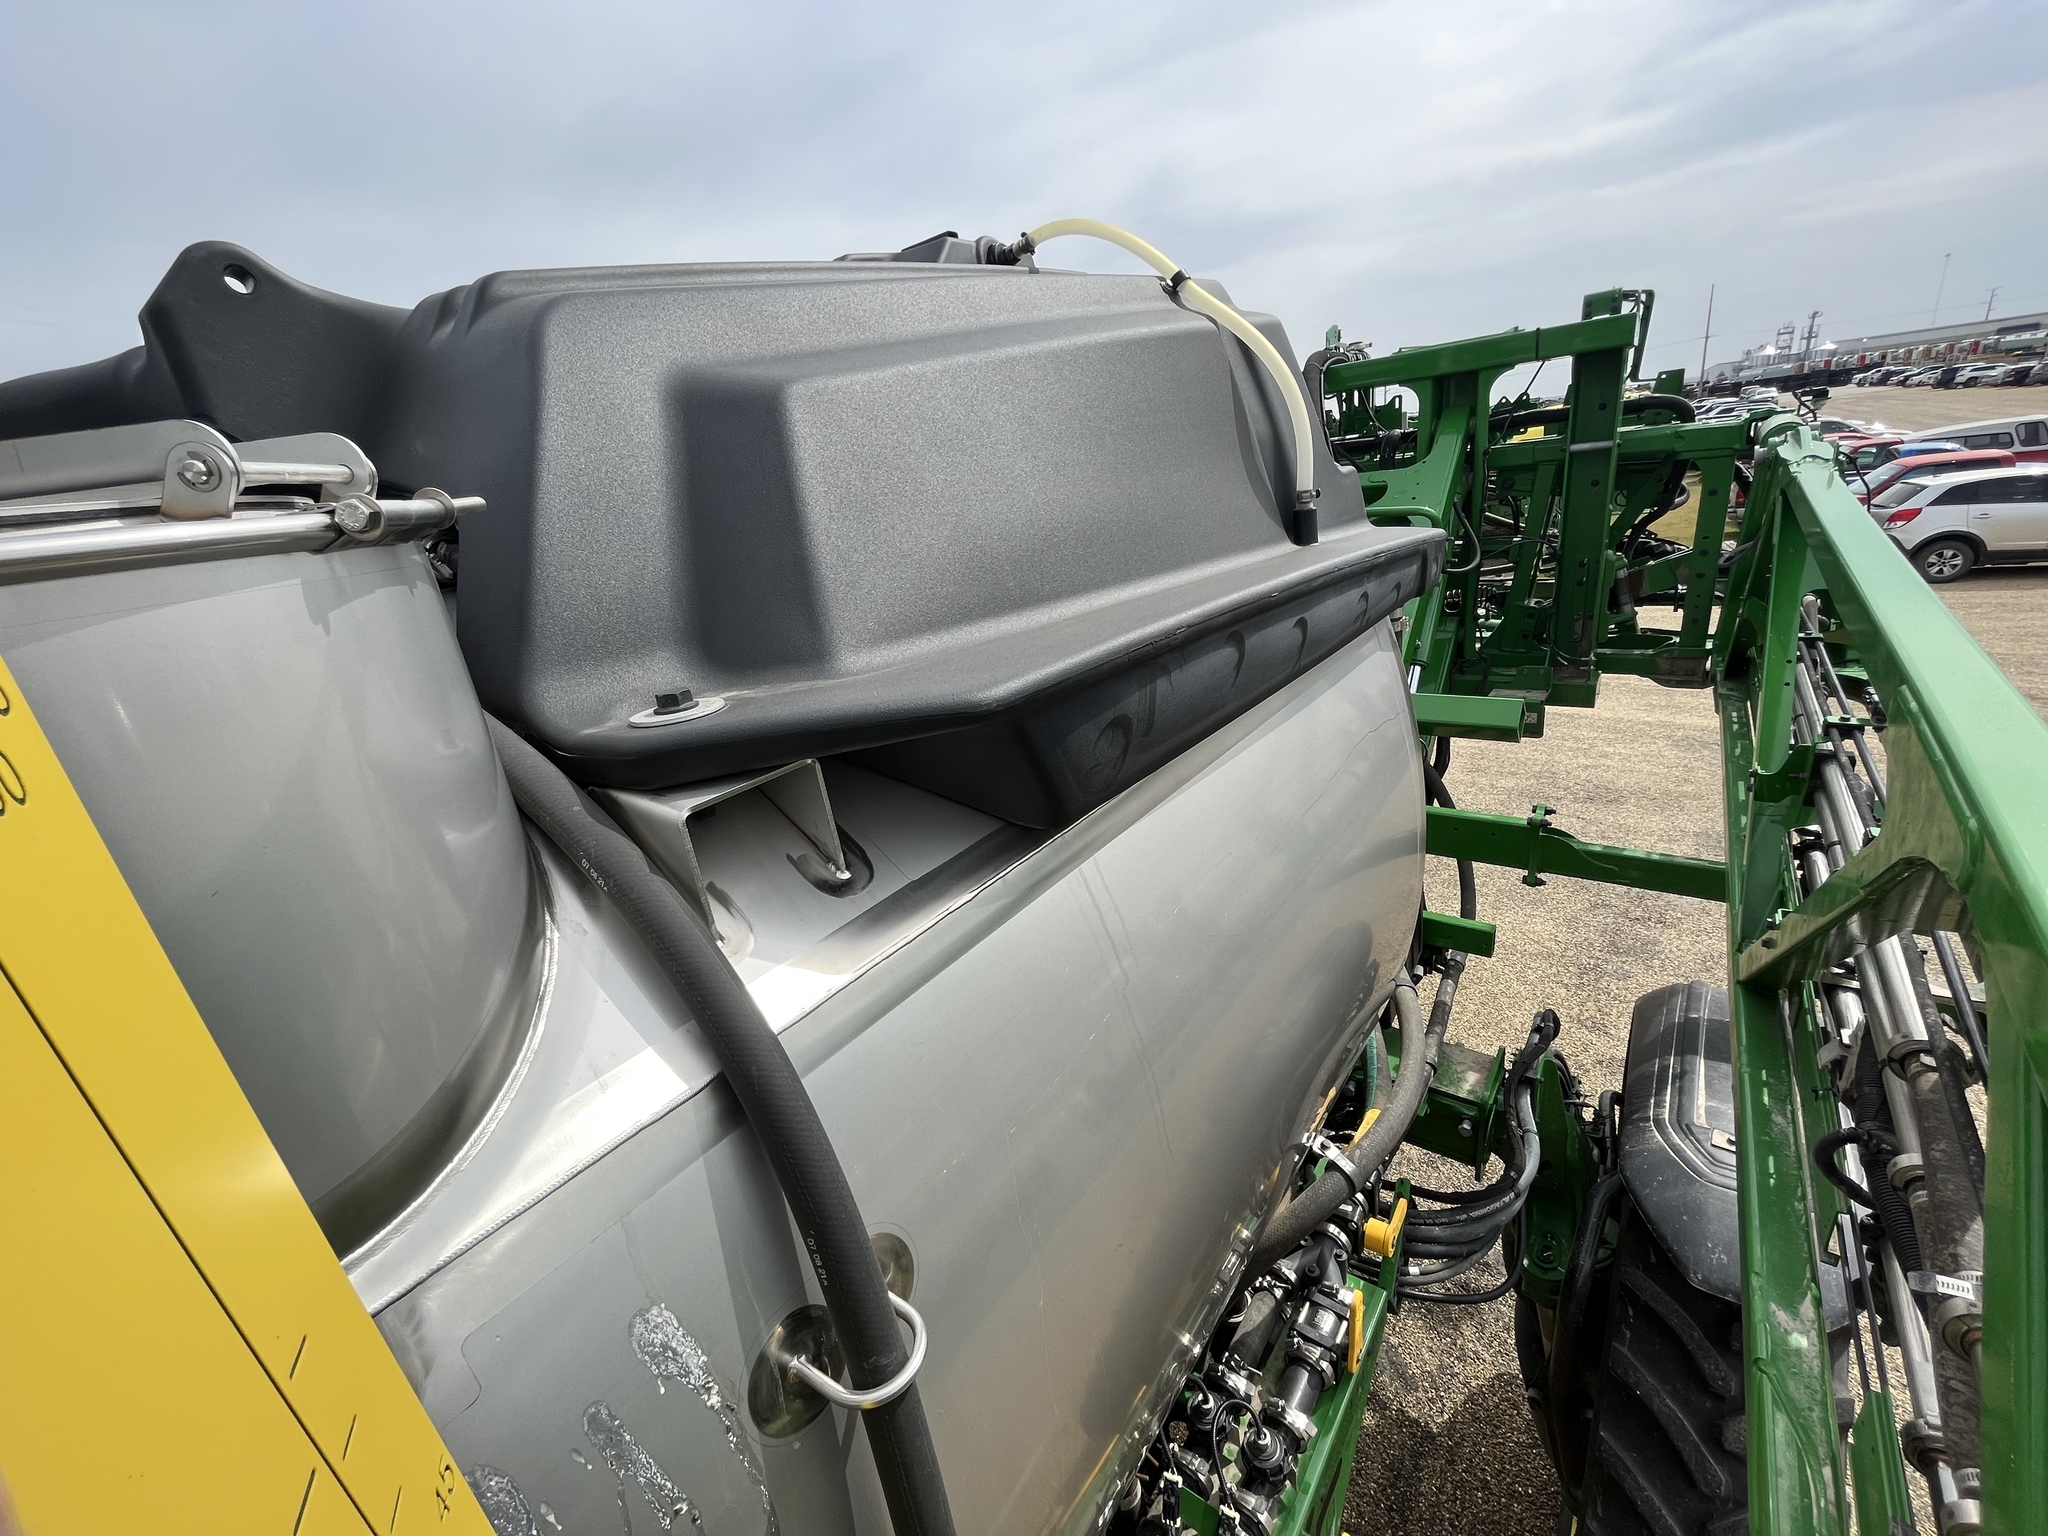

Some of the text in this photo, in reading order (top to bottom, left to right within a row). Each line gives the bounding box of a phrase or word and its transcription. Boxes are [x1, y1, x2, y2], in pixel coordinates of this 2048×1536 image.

[807, 1237, 817, 1251] 07
[818, 1267, 827, 1279] 21
[435, 1453, 455, 1523] 45
